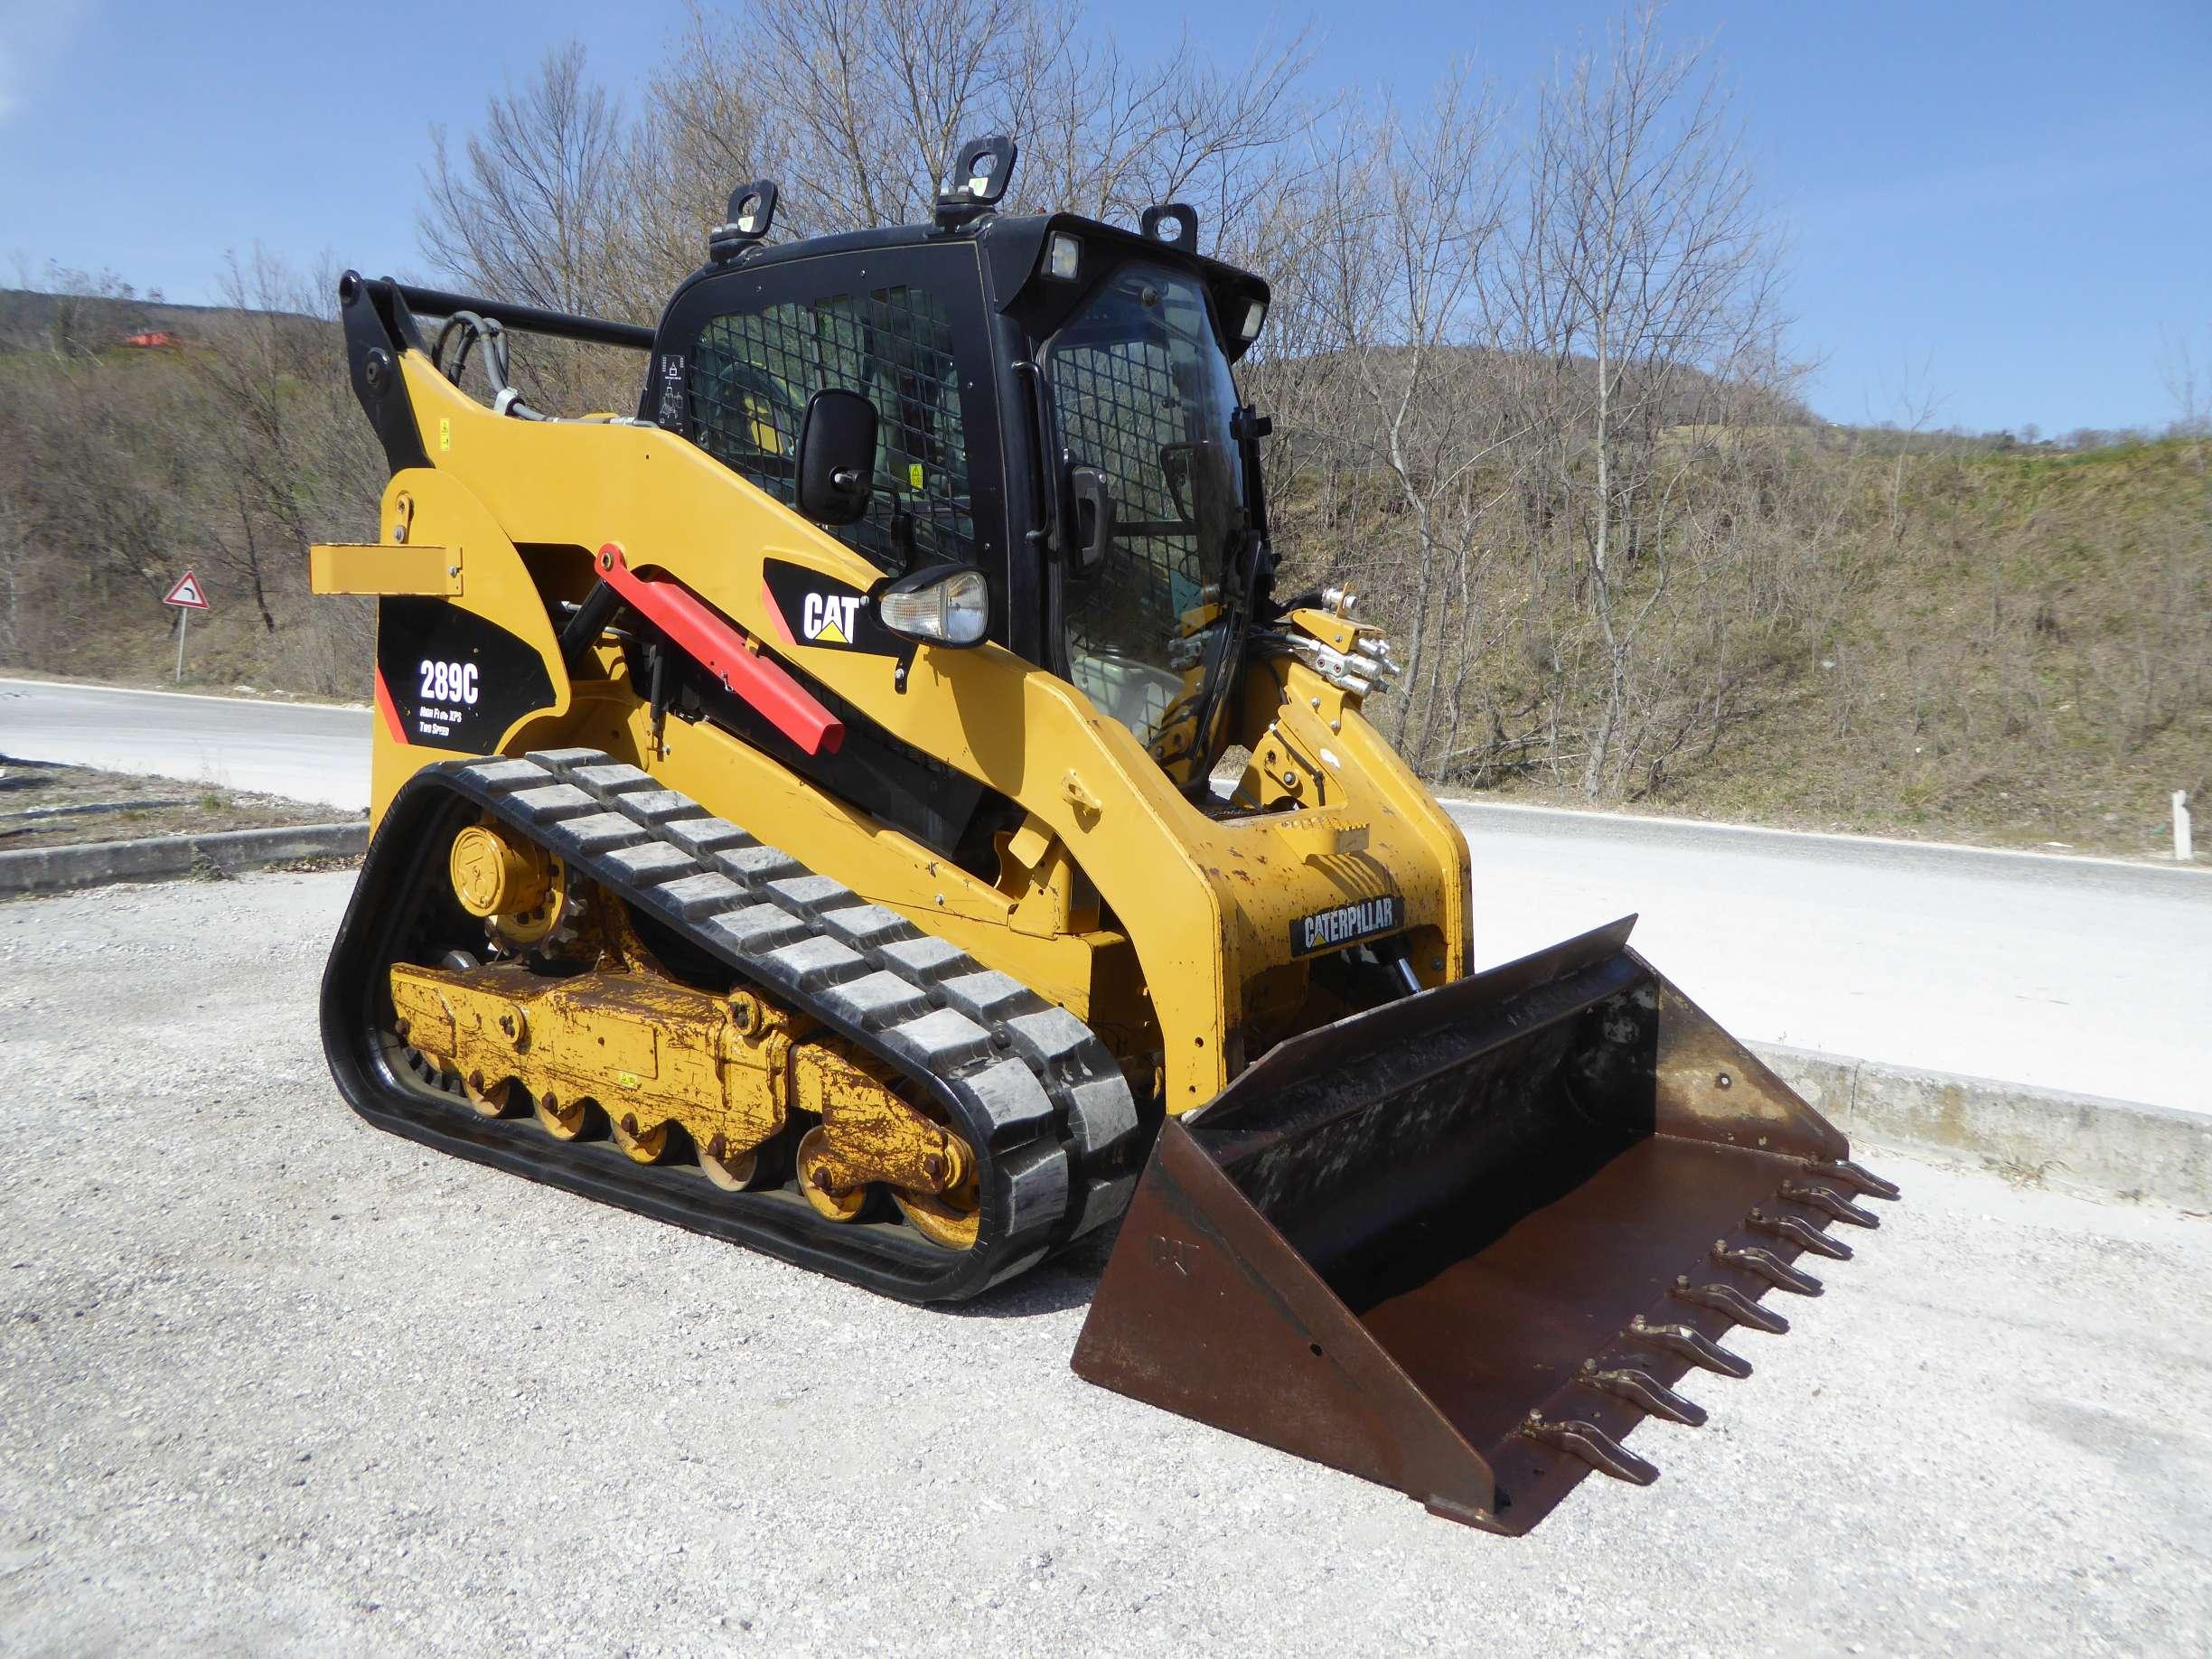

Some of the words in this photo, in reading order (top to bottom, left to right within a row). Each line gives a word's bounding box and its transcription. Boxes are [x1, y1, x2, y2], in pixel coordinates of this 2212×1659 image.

[803, 593, 860, 643] CAT
[420, 660, 479, 704] 289C
[1304, 897, 1392, 948] CATERPILLAR
